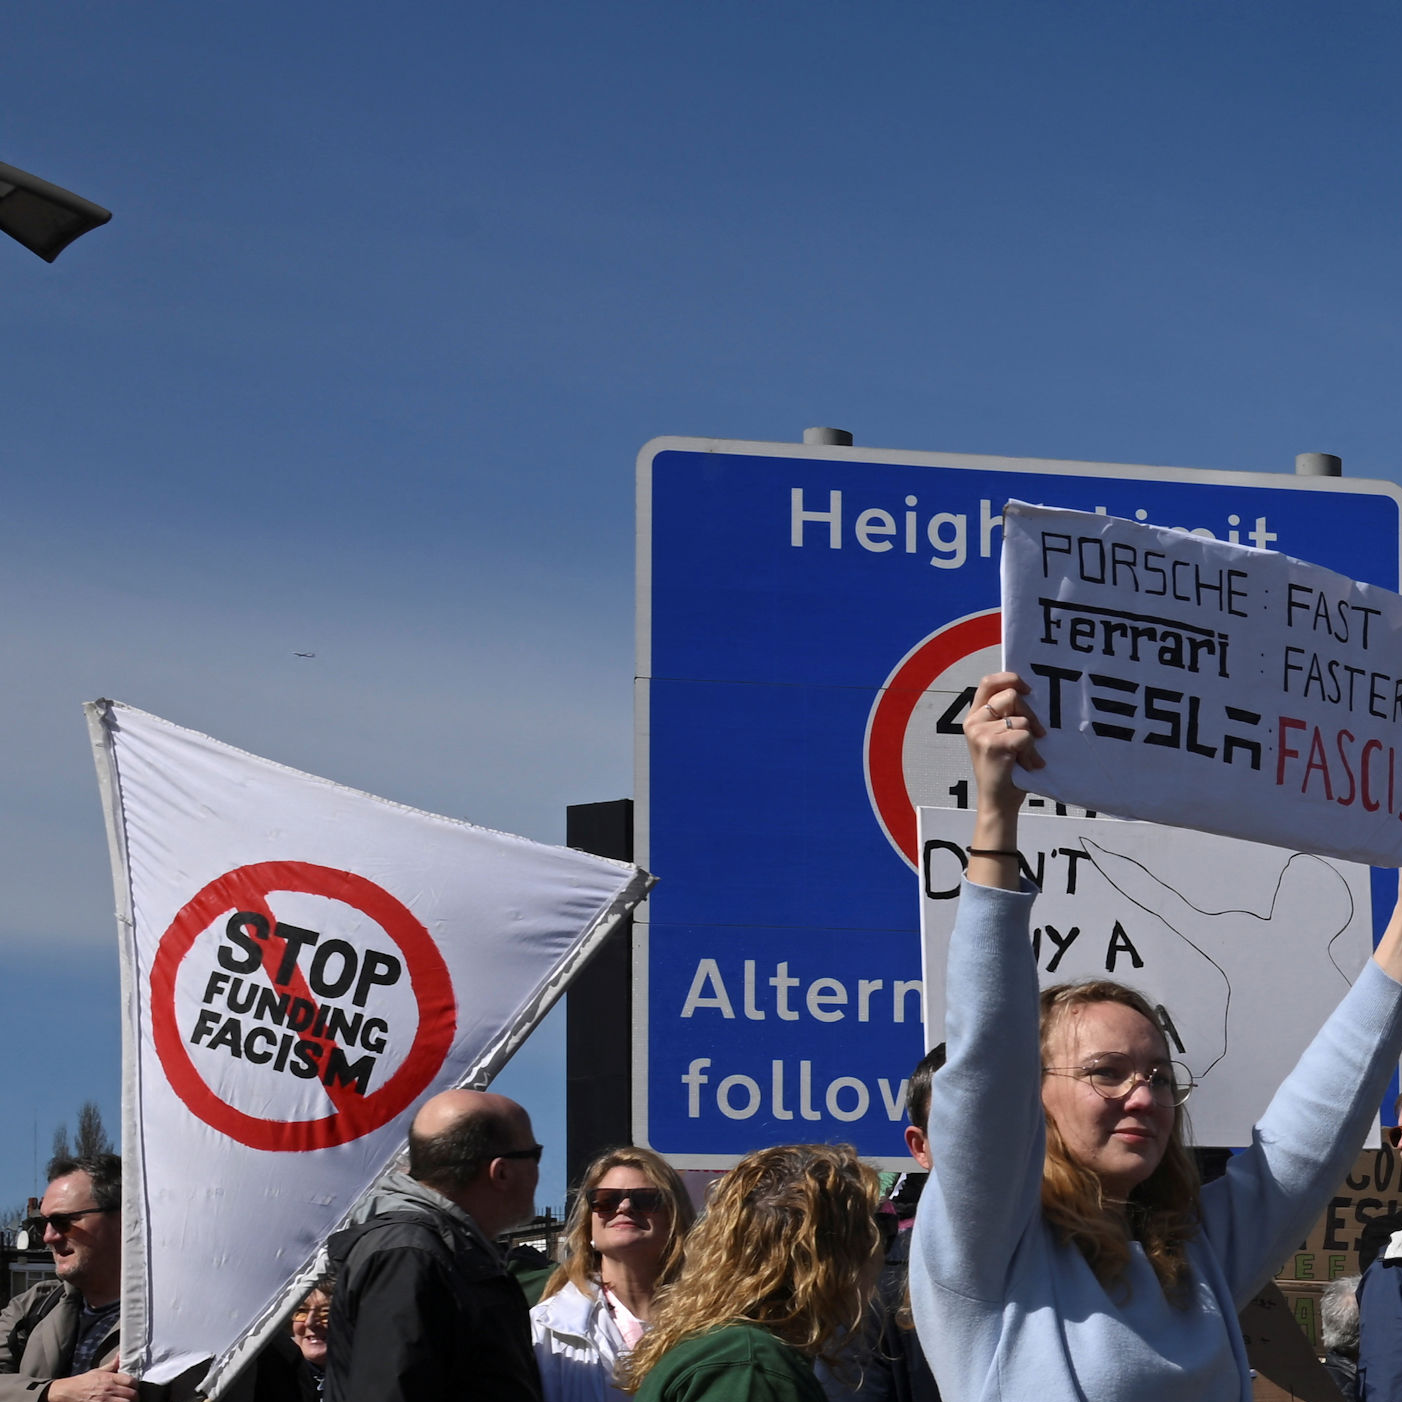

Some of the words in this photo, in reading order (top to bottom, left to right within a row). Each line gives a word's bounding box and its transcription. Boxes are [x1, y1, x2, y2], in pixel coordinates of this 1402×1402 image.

[790, 487, 1003, 569] Heigh
[1040, 531, 1249, 618] PORSCHE
[1286, 582, 1382, 651] FAST
[1038, 597, 1230, 678] Ferrari
[1030, 663, 1262, 771] TESLA
[924, 839, 1091, 900] DN'T
[217, 911, 402, 1008] STOP
[190, 1009, 377, 1096] FACISM
[202, 971, 389, 1055] FUNDING
